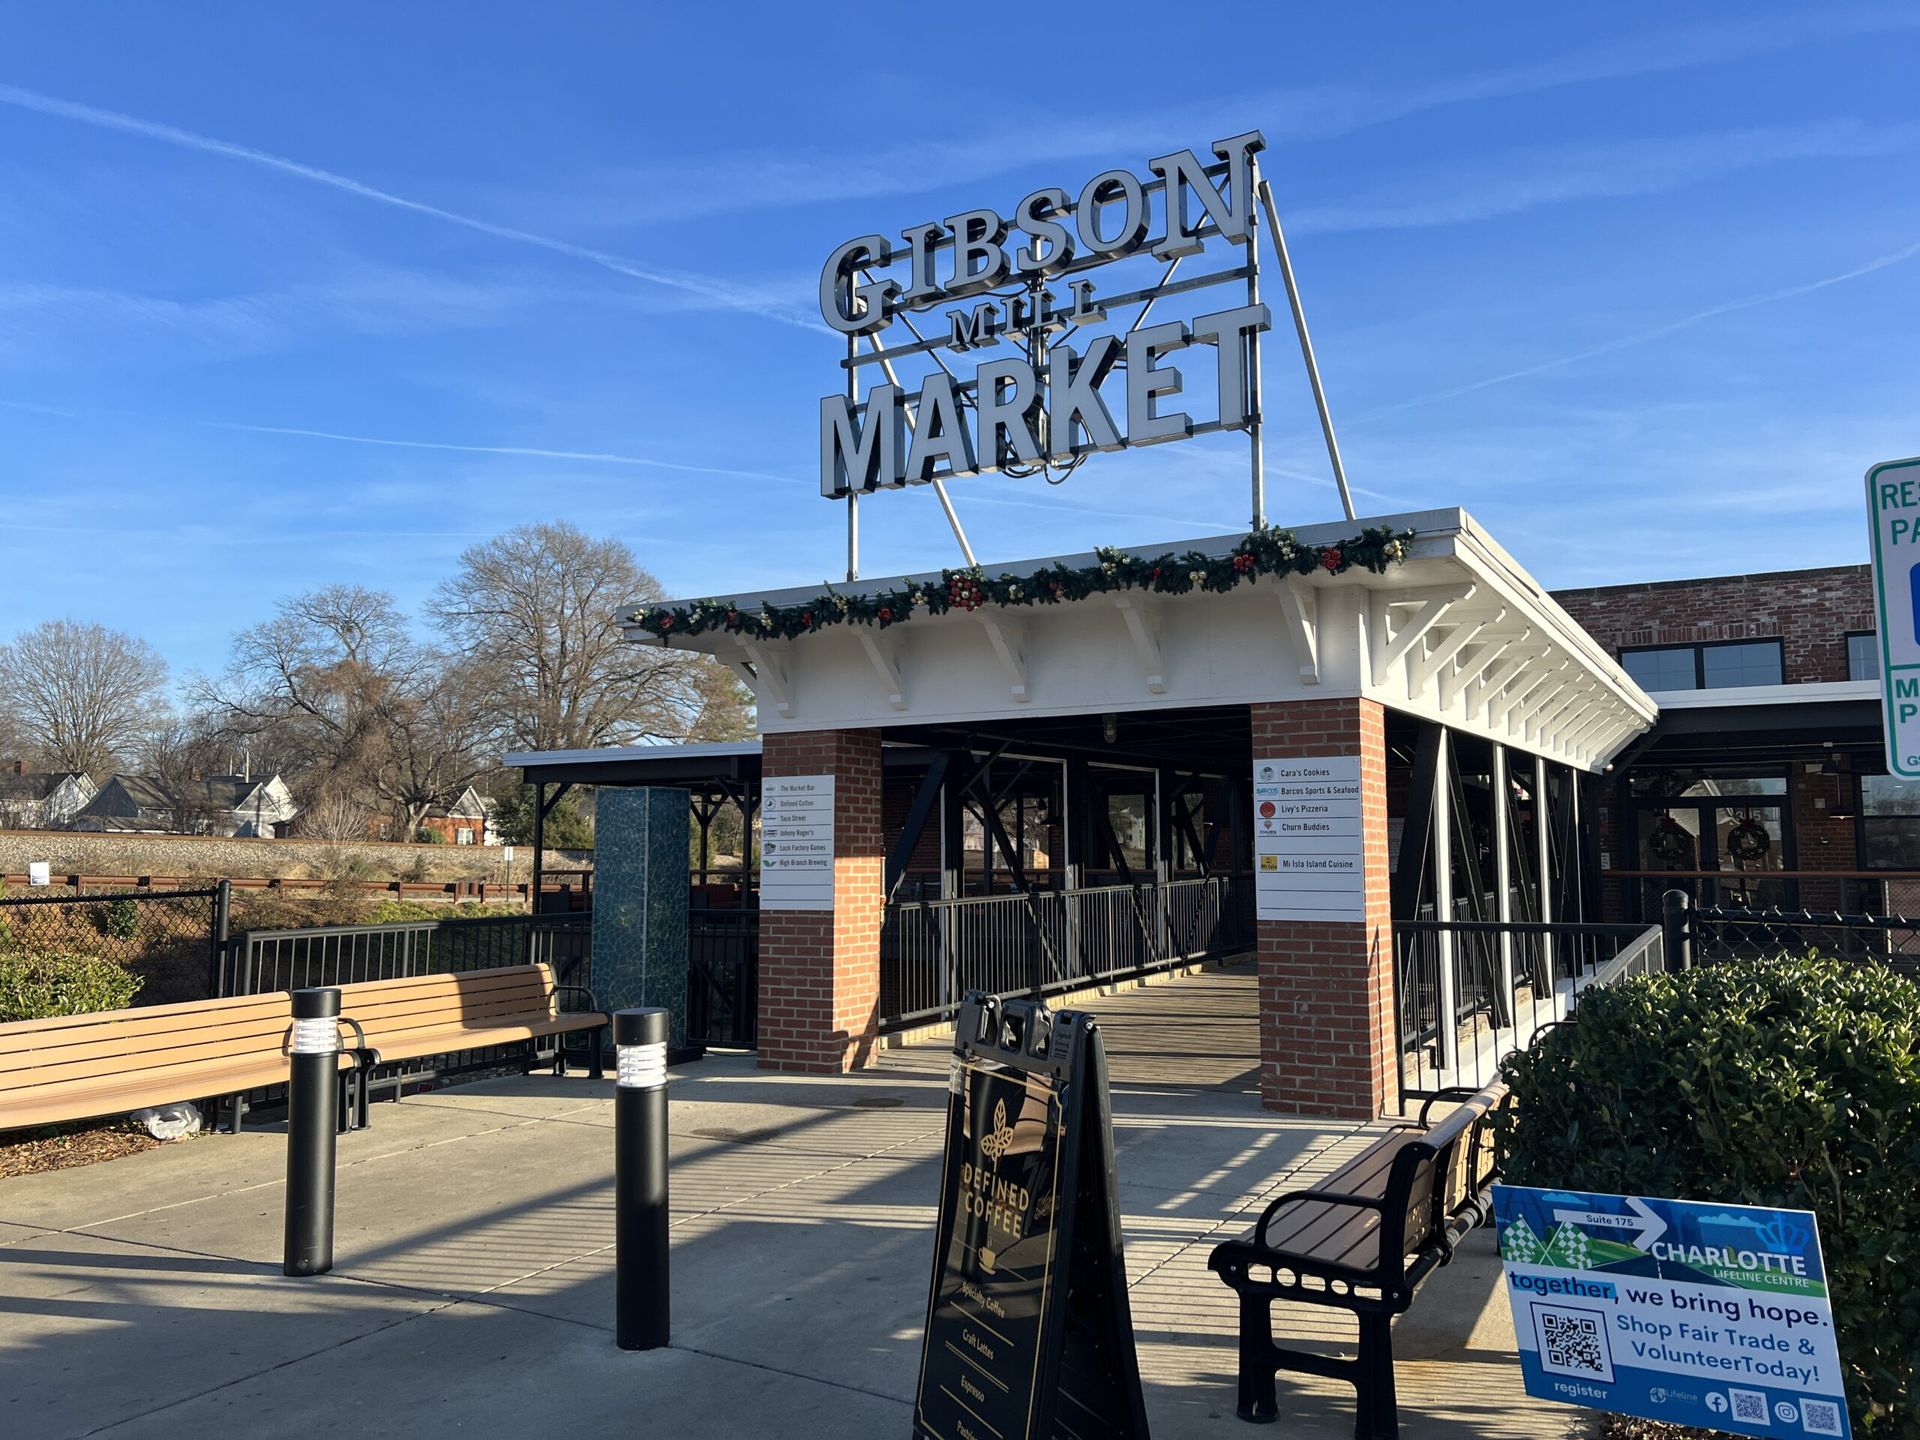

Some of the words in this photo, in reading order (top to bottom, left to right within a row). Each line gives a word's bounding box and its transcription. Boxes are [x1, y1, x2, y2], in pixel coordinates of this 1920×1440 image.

[820, 130, 1266, 336] GIBSON
[946, 279, 1107, 352] MILL
[820, 303, 1271, 499] MARKET
[1881, 481, 1920, 510] RE
[1280, 769, 1302, 777] Cara's
[1303, 768, 1330, 776] Cookies
[1281, 787, 1303, 795] Barcos
[1305, 787, 1325, 796] Sports
[1327, 786, 1331, 794] &
[1333, 785, 1359, 794] Seafood
[1281, 805, 1300, 814] Livy's
[1301, 804, 1328, 813] Pizzeria
[1282, 823, 1301, 831] Churn
[1303, 822, 1330, 831] Buddies
[792, 844, 809, 852] Factory
[1283, 860, 1290, 868] Mi
[1292, 860, 1304, 868] Isla
[1306, 860, 1326, 868] Island
[1328, 860, 1353, 868] Cuisine
[964, 1161, 1029, 1211] DEFINED
[965, 1191, 1022, 1239] COFFEE
[1586, 1214, 1612, 1225] Suite
[1615, 1217, 1634, 1227] 175
[1651, 1241, 1807, 1276] CHARLOTTE
[1713, 1269, 1761, 1283] LIFELINE
[1764, 1273, 1810, 1288] CENTRE
[962, 1281, 986, 1308] Specialty
[986, 1297, 1005, 1318] Coffee
[1509, 1271, 1619, 1304] together,
[1626, 1288, 1663, 1306] we
[1670, 1289, 1741, 1322] bring
[1749, 1298, 1828, 1328] hope.
[962, 1328, 977, 1348] Craft
[976, 1337, 994, 1360] Lattes
[1616, 1314, 1672, 1340] Shop
[1678, 1322, 1719, 1343] Fair
[1724, 1328, 1790, 1352] Trade
[1798, 1338, 1815, 1355] &
[960, 1374, 985, 1403] Espresso
[1554, 1382, 1608, 1399] register
